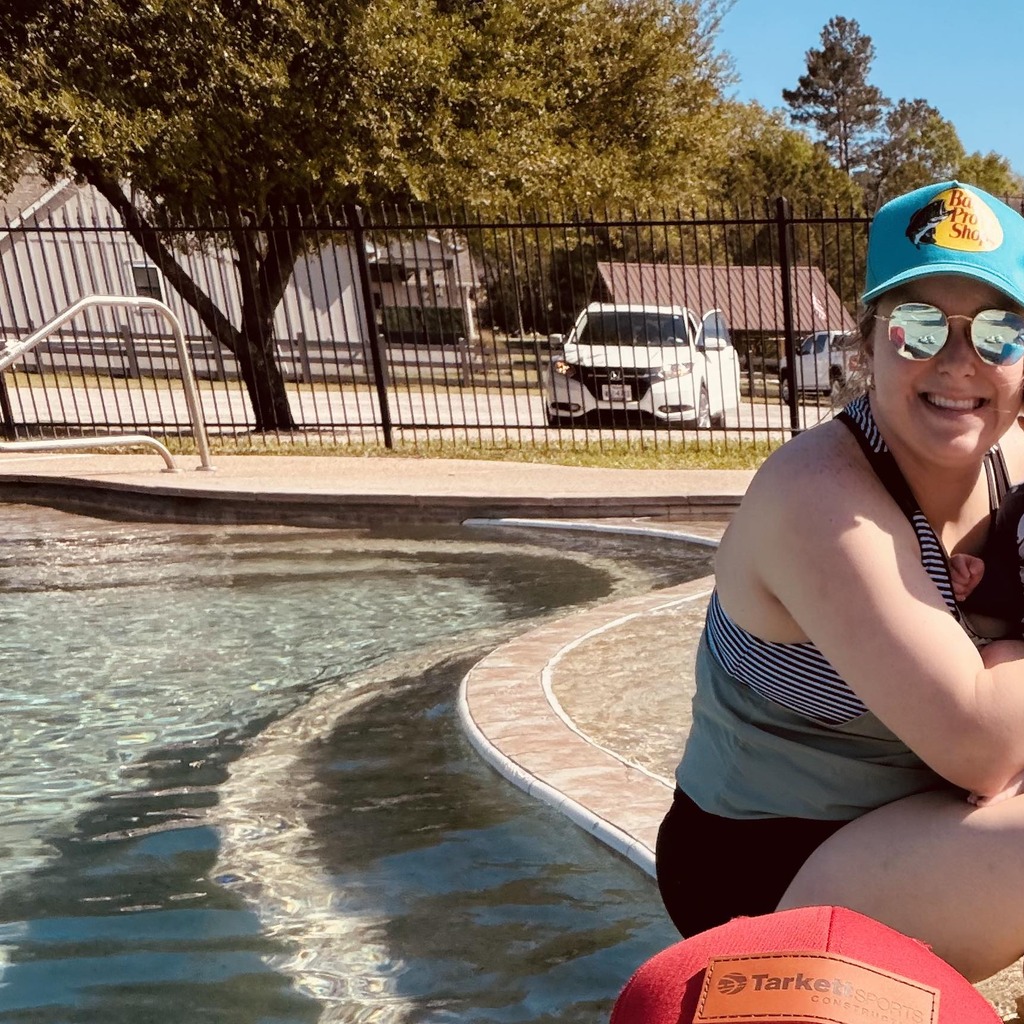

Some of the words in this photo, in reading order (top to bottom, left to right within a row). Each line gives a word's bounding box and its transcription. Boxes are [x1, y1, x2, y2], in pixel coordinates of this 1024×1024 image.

[949, 207, 979, 226] Pro
[948, 222, 994, 247] Sho
[854, 987, 925, 1024] SPORTS
